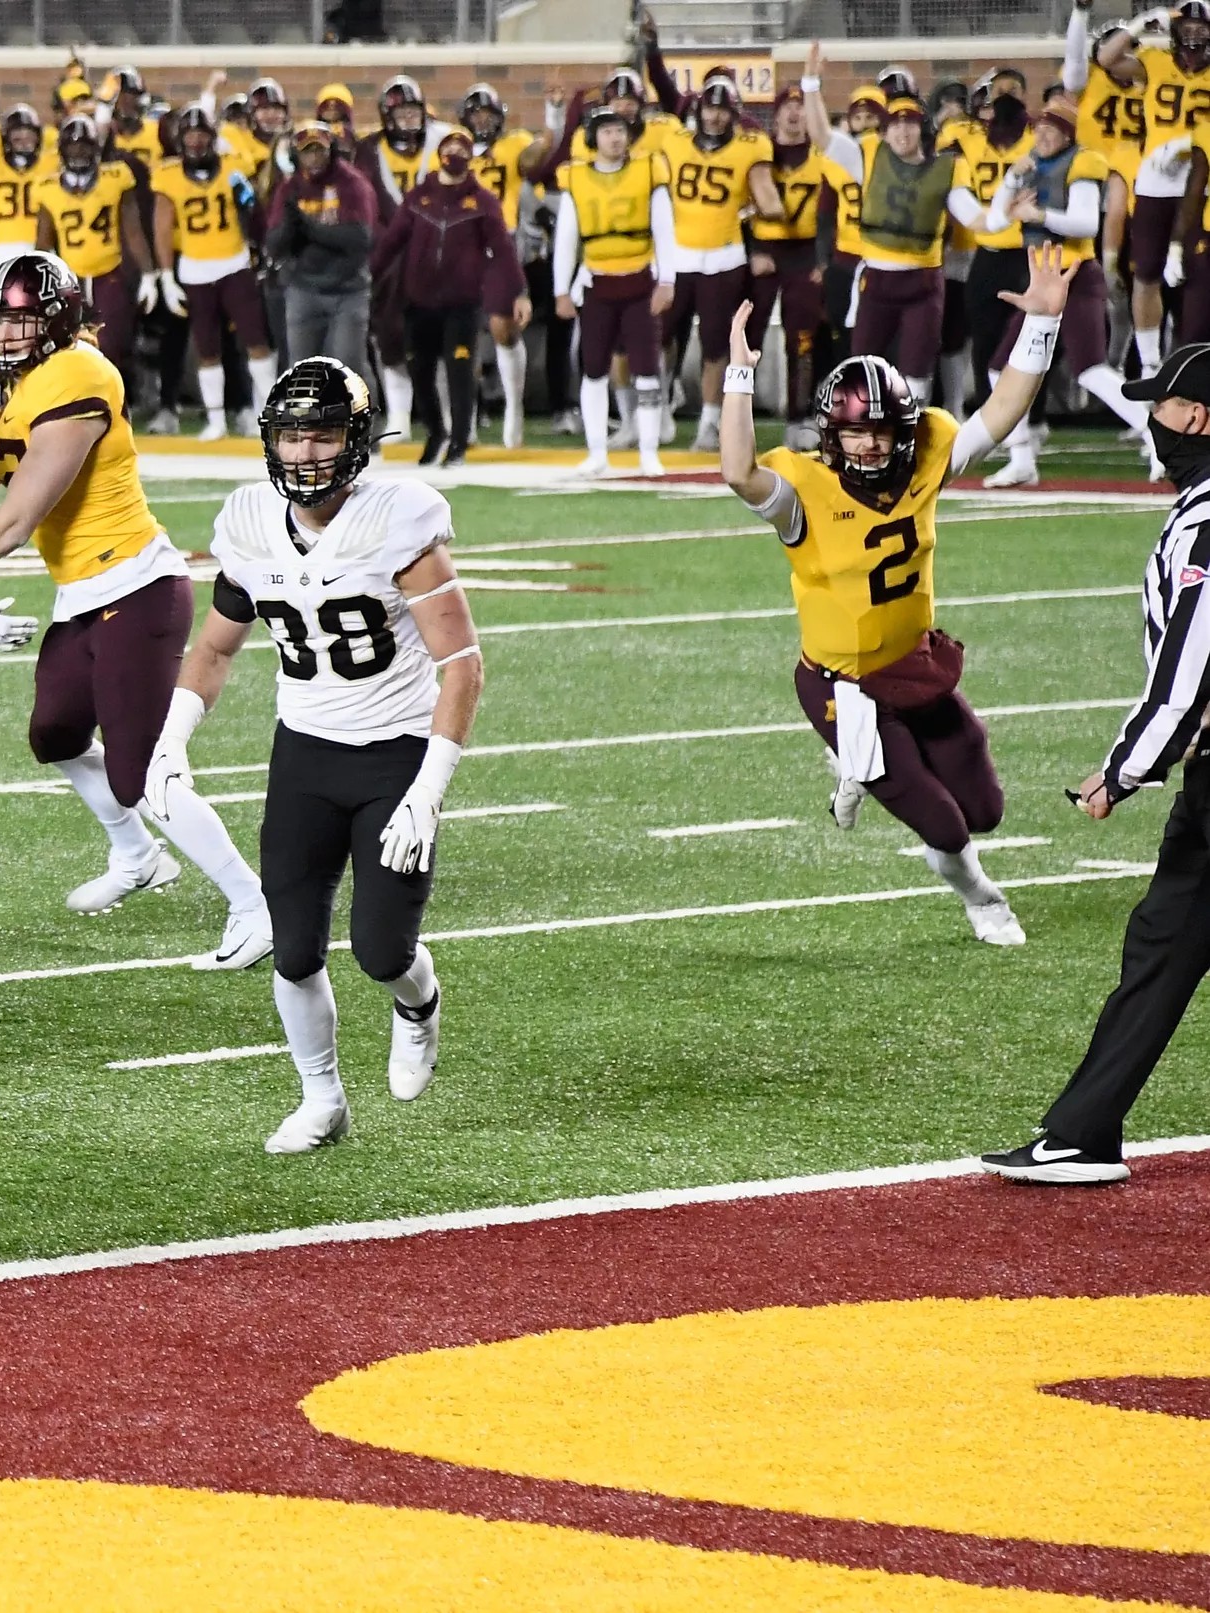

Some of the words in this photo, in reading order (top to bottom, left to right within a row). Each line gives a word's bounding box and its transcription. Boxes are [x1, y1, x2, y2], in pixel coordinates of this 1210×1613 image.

[1093, 95, 1147, 138] 49
[676, 162, 735, 205] 85
[60, 204, 114, 249] 24
[184, 192, 230, 234] 21
[864, 515, 920, 606] 2
[255, 594, 397, 681] 38
